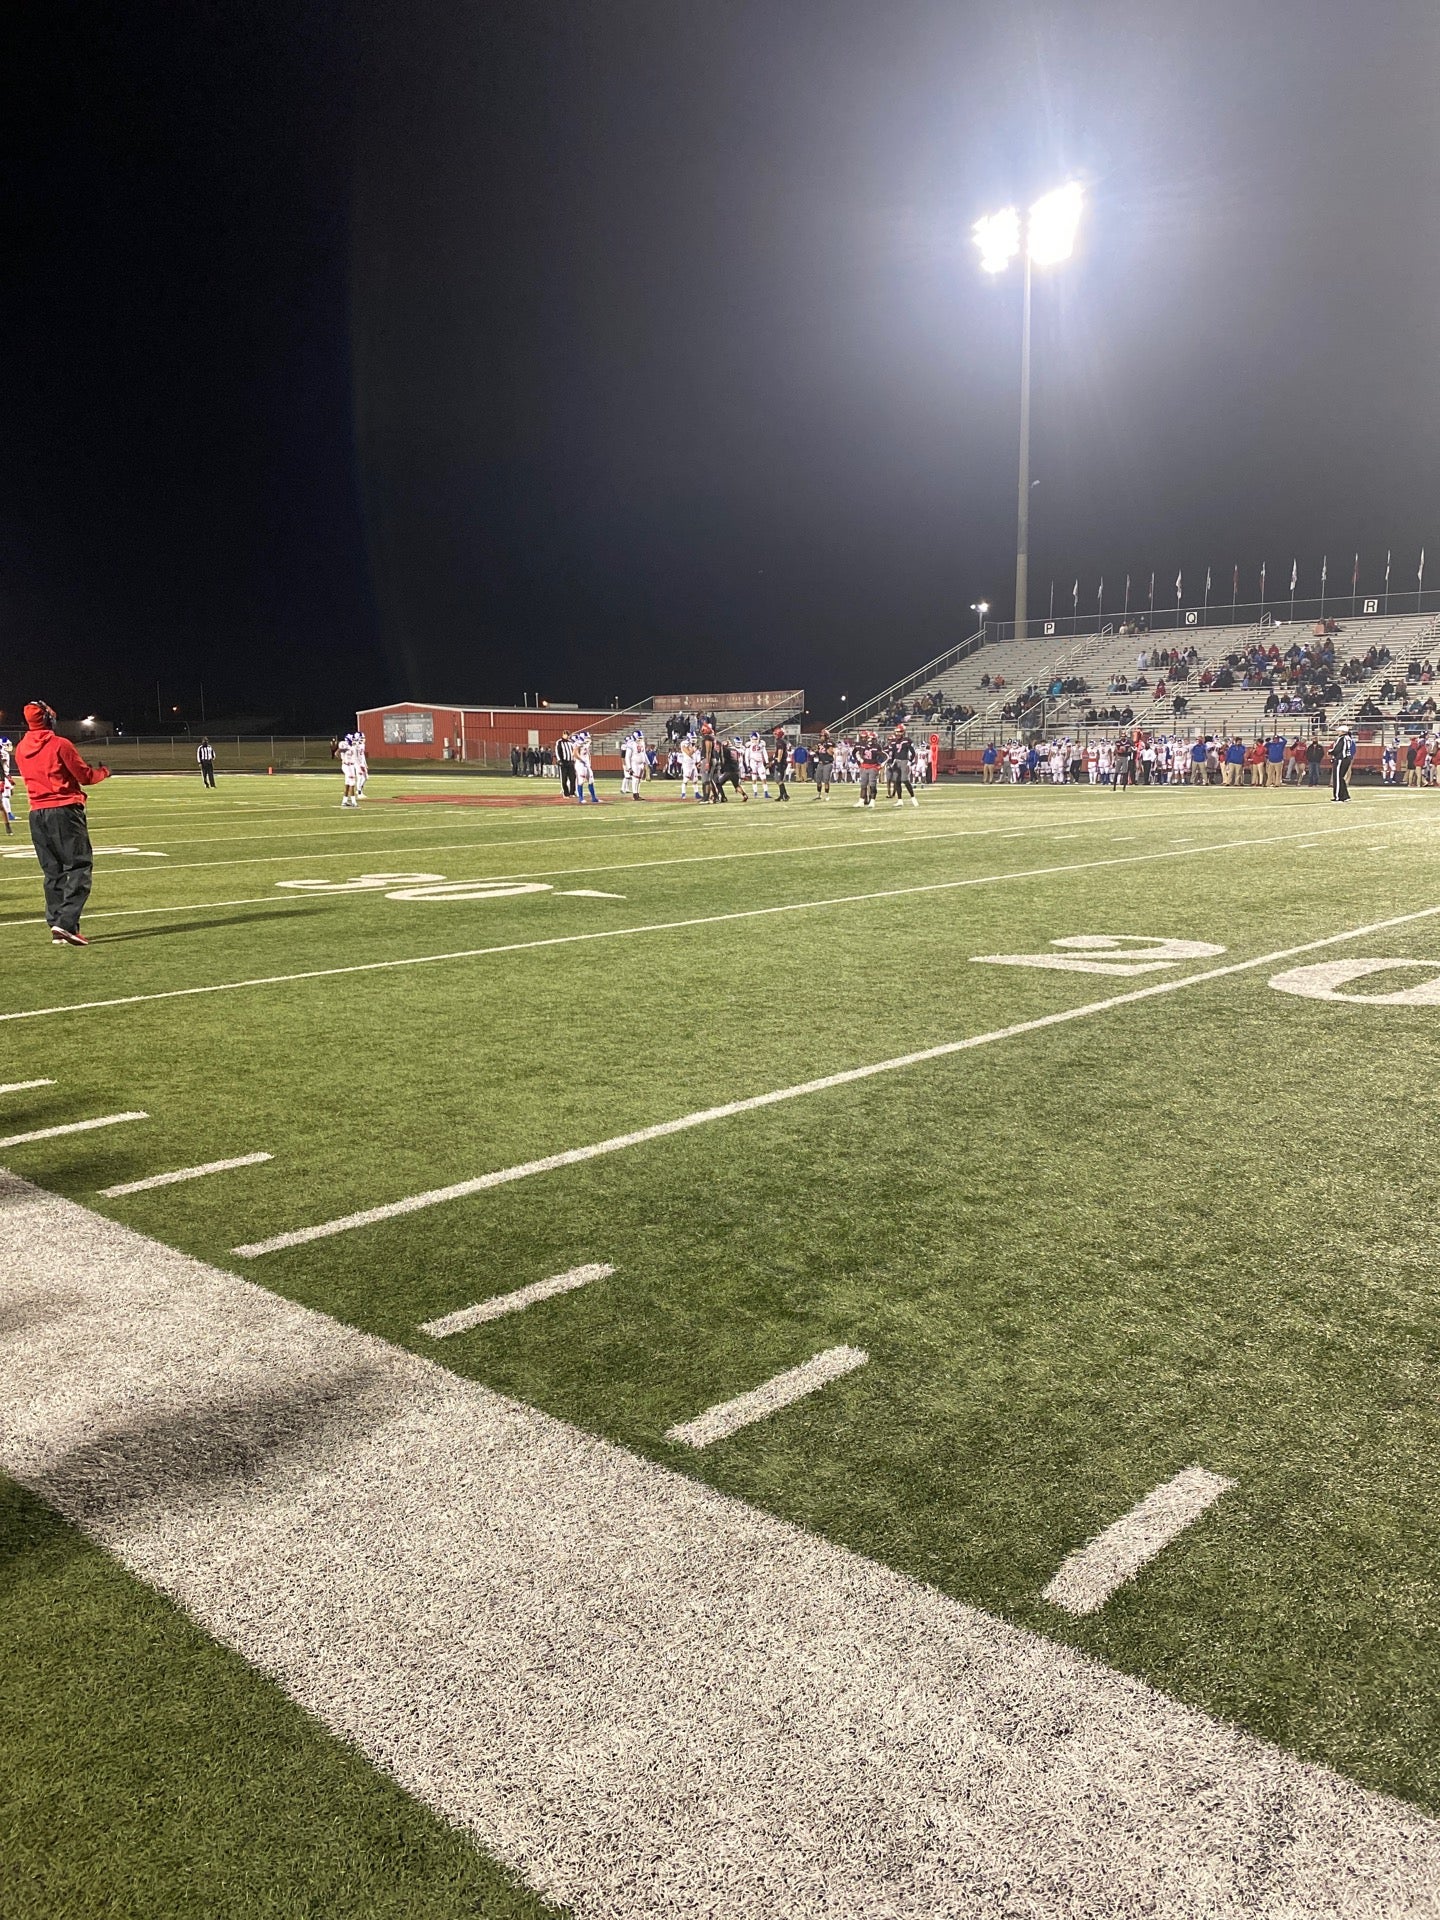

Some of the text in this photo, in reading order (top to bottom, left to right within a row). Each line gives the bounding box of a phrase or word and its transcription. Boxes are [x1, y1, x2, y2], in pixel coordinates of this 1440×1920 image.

[1366, 602, 1376, 612] R
[1187, 613, 1197, 624] Q
[1046, 624, 1053, 634] P
[275, 872, 553, 901] 30
[968, 934, 1440, 1005] 20
